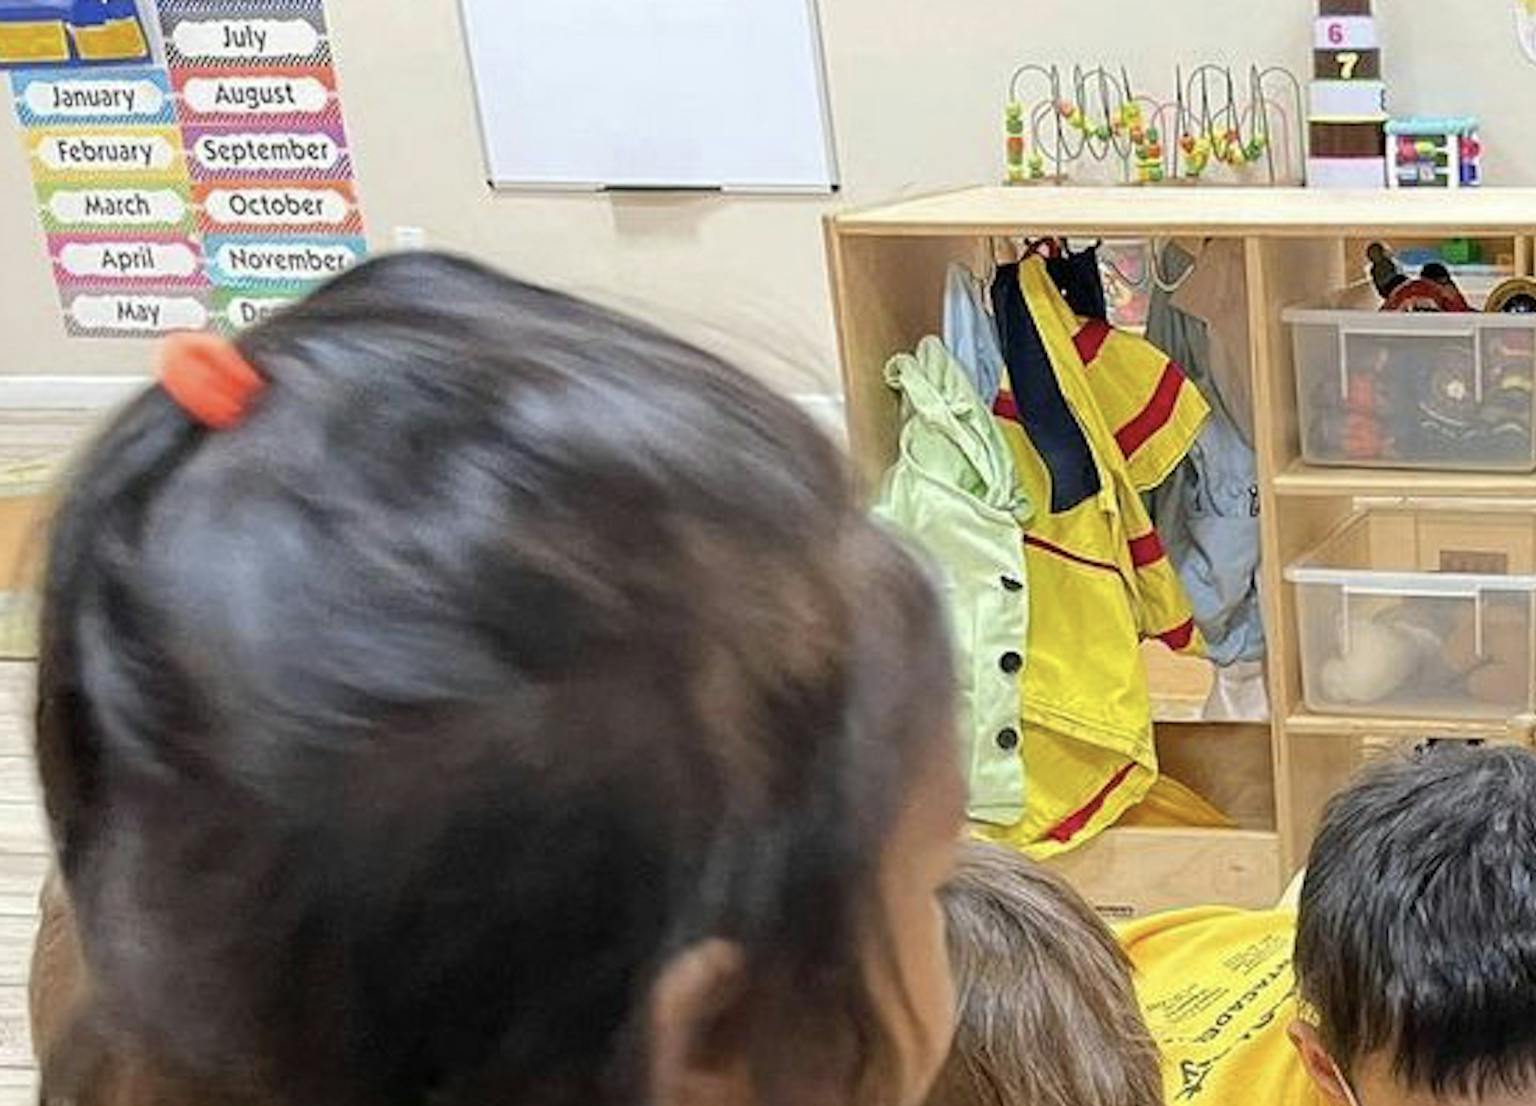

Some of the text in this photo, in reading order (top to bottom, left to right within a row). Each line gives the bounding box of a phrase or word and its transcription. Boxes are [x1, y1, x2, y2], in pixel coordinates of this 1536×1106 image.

[222, 26, 267, 53] July
[1327, 23, 1344, 44] 6
[1335, 52, 1359, 80] 7
[53, 86, 136, 110] January
[215, 84, 297, 109] August
[58, 141, 153, 165] February
[203, 140, 329, 165] September
[85, 193, 150, 216] March
[229, 193, 324, 216] October
[101, 246, 155, 272] April
[229, 249, 346, 271] November
[117, 301, 161, 324] May
